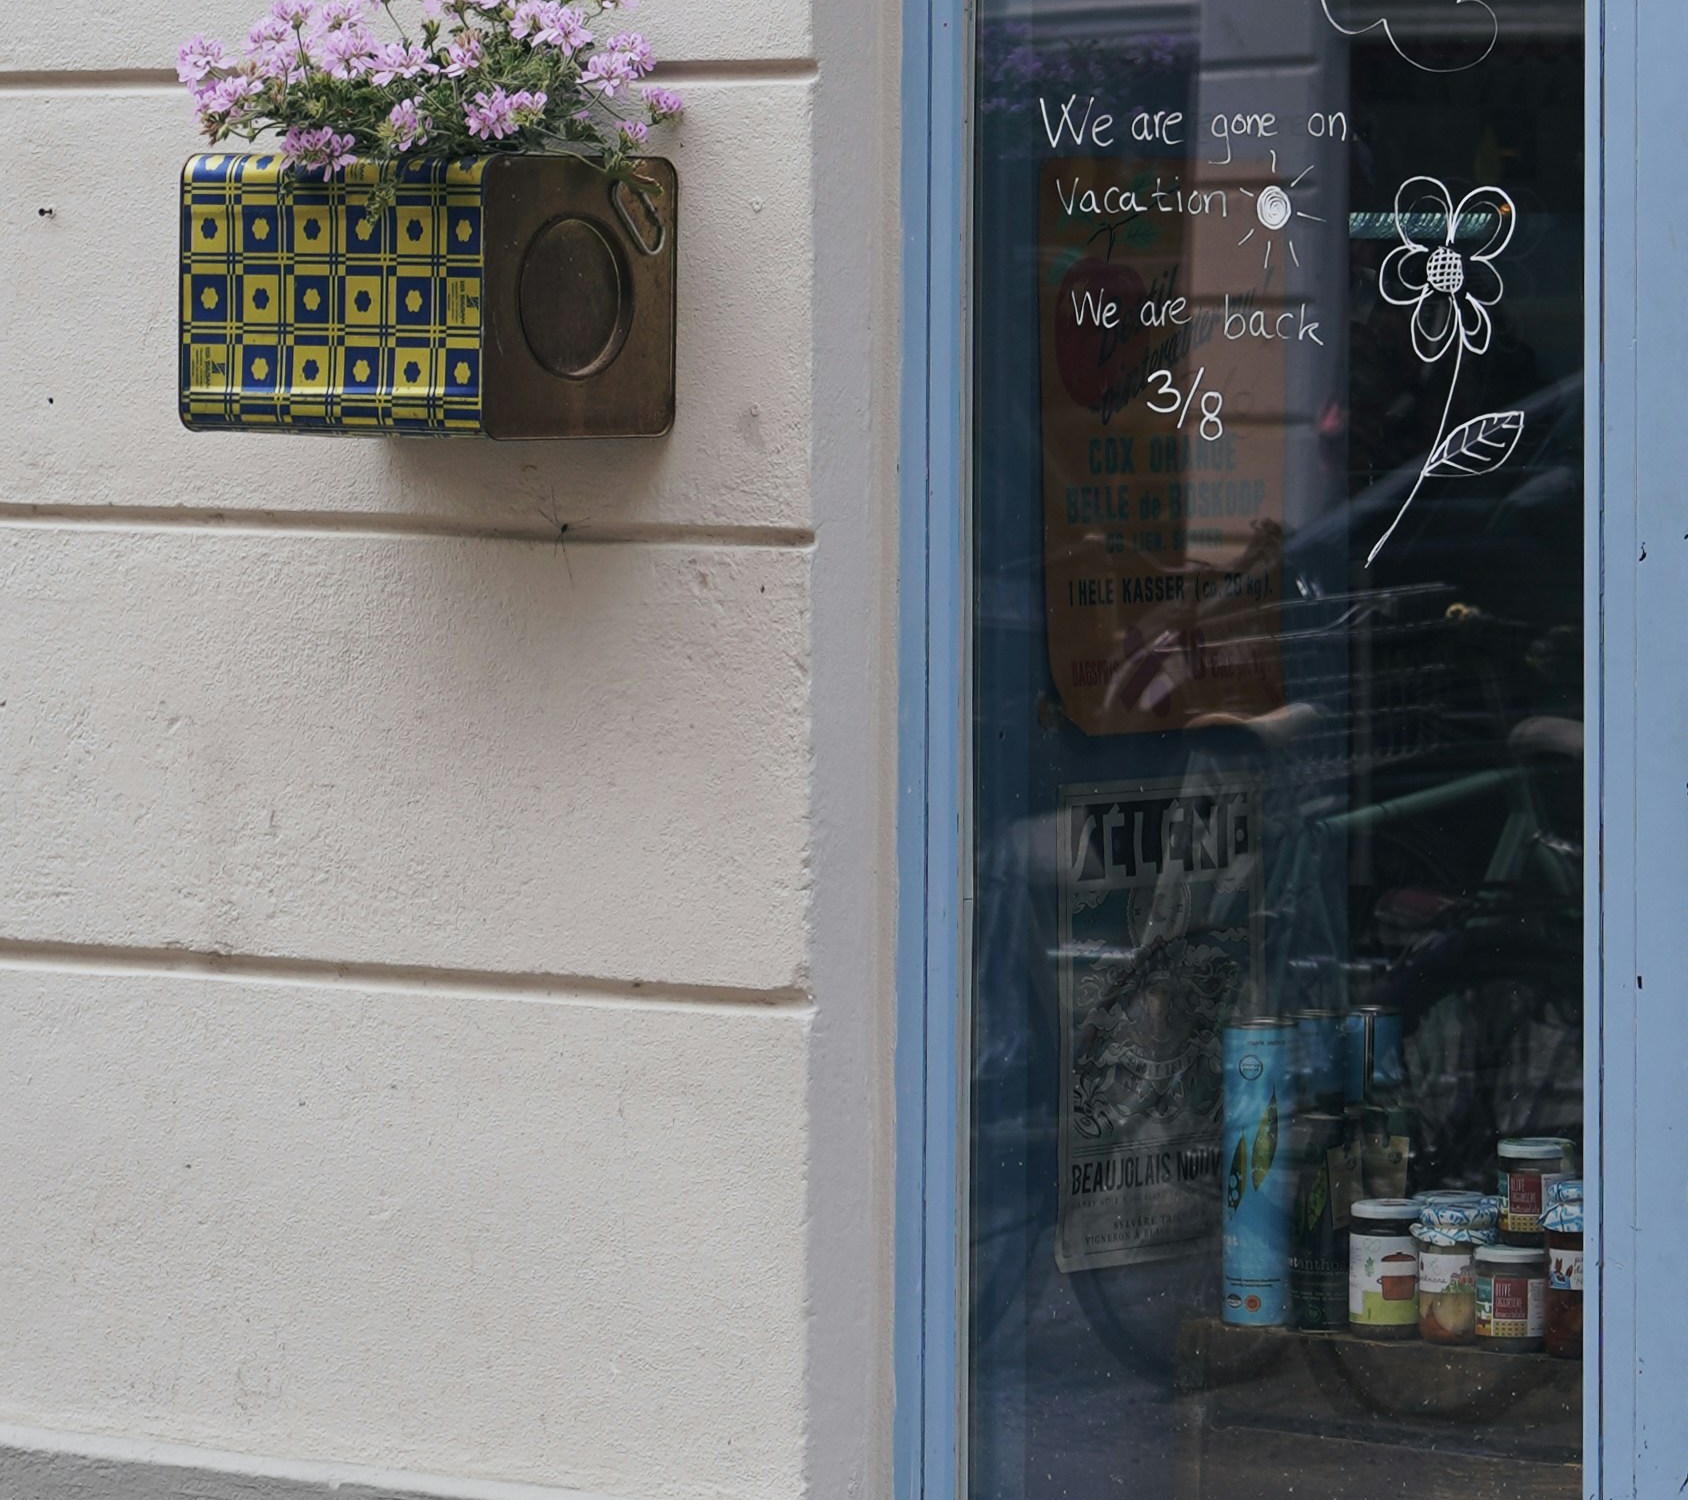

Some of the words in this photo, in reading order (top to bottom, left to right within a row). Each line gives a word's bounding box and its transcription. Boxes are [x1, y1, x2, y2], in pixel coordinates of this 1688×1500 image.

[1039, 93, 1115, 149] We
[1131, 111, 1185, 145] are
[1209, 111, 1279, 165] gone
[1307, 110, 1349, 143] on
[1056, 178, 1228, 218] Vacation
[1071, 288, 1120, 328] We
[1140, 296, 1192, 328] are
[1224, 292, 1325, 346] back
[1146, 367, 1223, 441] 3/8
[1088, 436, 1136, 475] COX
[1139, 488, 1161, 521] de
[1079, 578, 1114, 607] HELE
[1122, 575, 1185, 604] KASSER
[1071, 1152, 1171, 1196] BEAUJOLAIS
[1177, 1148, 1224, 1182] NOUV
